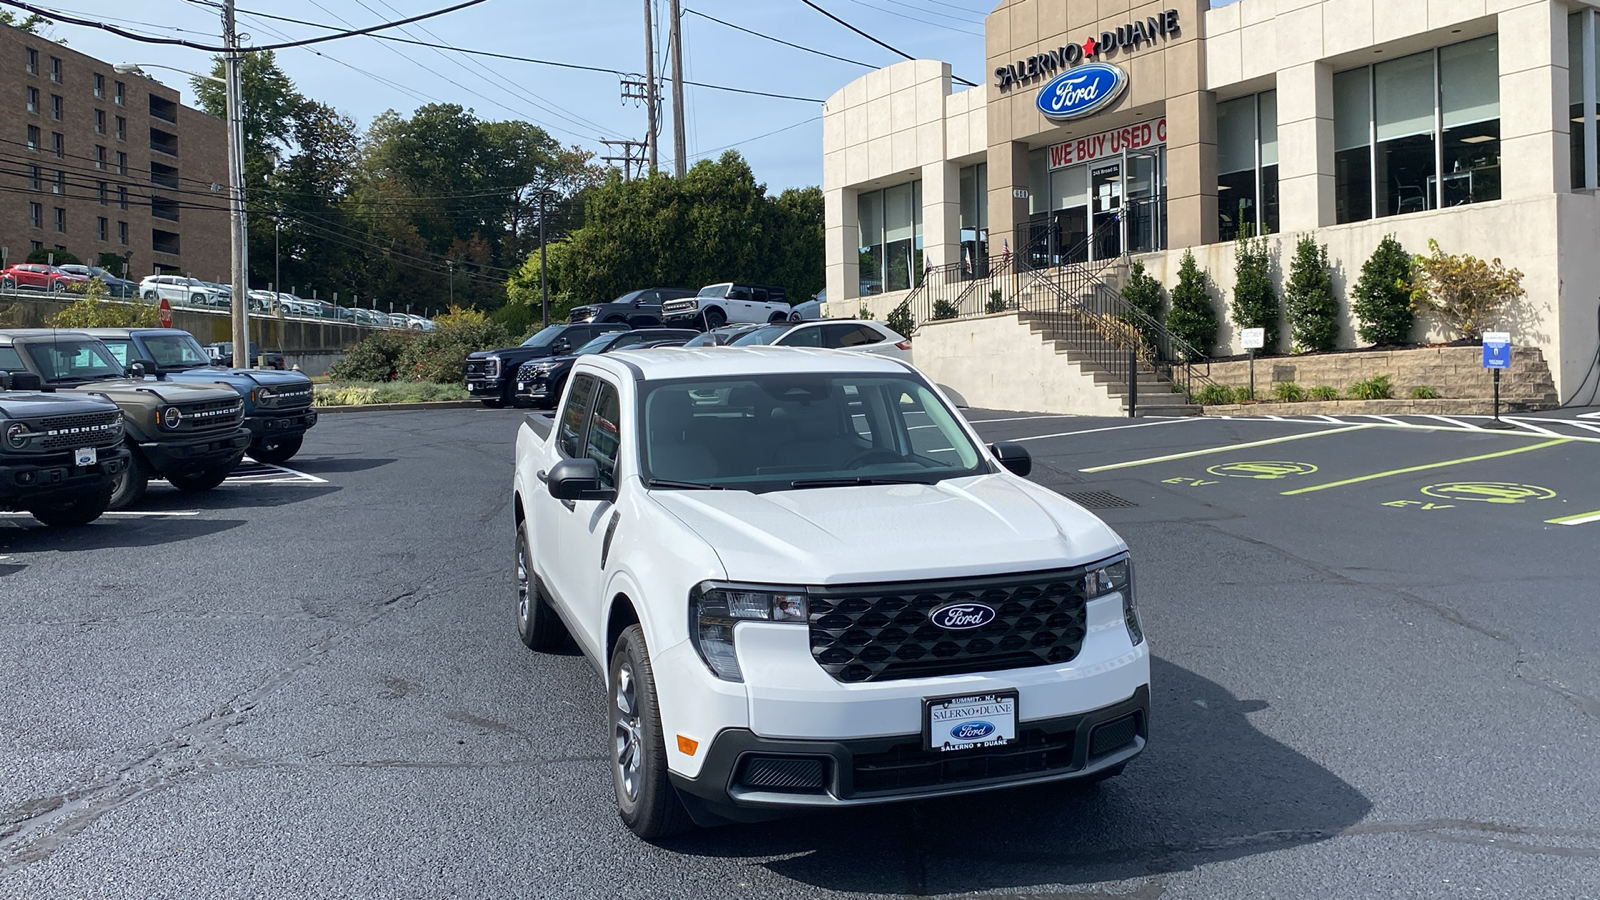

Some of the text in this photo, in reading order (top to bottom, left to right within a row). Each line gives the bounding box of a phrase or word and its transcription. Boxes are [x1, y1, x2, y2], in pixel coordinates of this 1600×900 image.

[994, 9, 1180, 88] SALERNO DUANE
[1052, 75, 1100, 110] Ford
[1051, 143, 1073, 167] WE
[1077, 134, 1106, 161] BUY
[1111, 123, 1152, 153] USED
[161, 308, 171, 321] STOP
[194, 408, 235, 418] BRONCO
[48, 424, 108, 436] BRONCO
[1162, 476, 1220, 486] EV
[1381, 500, 1456, 510] EV
[945, 607, 983, 626] Ford
[934, 704, 1012, 720] SALERNO DUANE
[959, 724, 986, 737] Ford
[941, 739, 1007, 752] SALERNO DUANE
